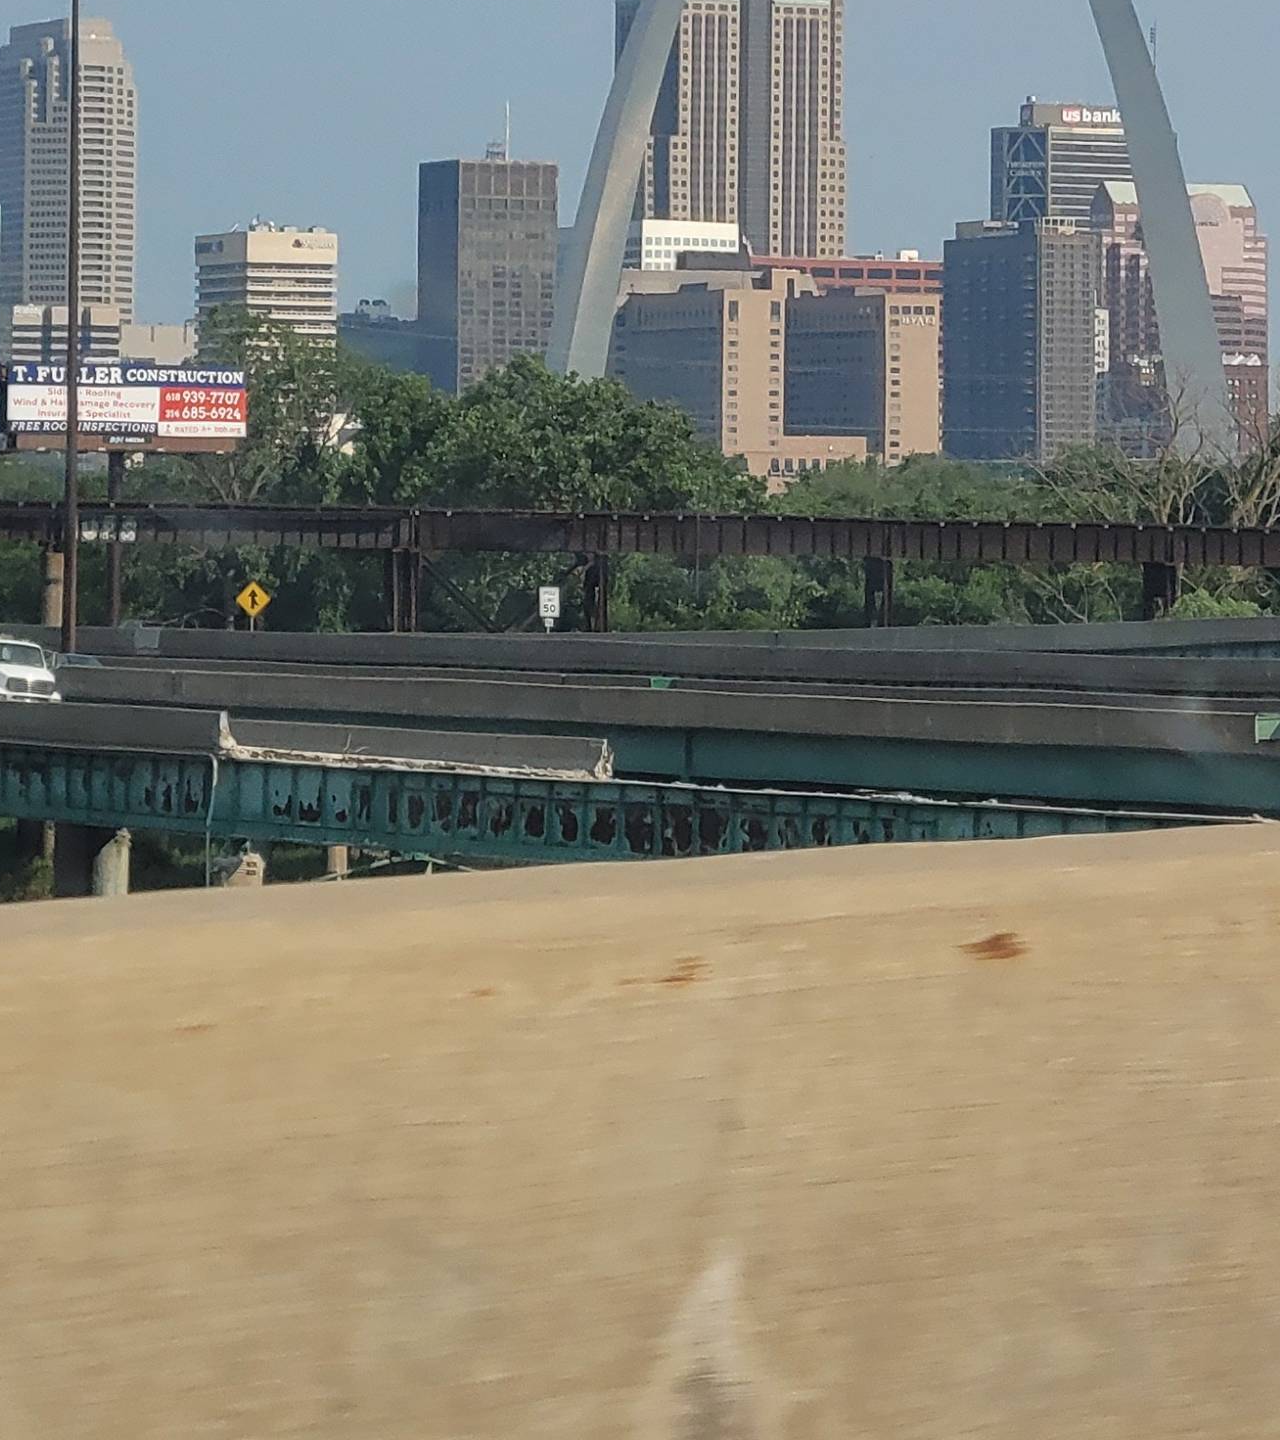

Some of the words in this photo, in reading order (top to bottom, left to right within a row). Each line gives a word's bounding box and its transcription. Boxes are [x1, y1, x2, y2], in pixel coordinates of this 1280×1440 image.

[36, 366, 123, 384] FULER
[126, 368, 244, 384] CONSTRUCTION
[85, 389, 122, 399] Roofing
[165, 391, 181, 401] 618
[182, 390, 240, 405] 939-7707
[12, 398, 38, 406] Wind
[79, 400, 110, 409] amage
[112, 400, 156, 411] Recovery
[85, 409, 131, 418] Specialist
[182, 406, 241, 420] 685-6924
[11, 421, 41, 431] FREE
[42, 421, 68, 431] ROO
[77, 422, 156, 433] INSPECTIONS
[543, 603, 556, 613] 50
